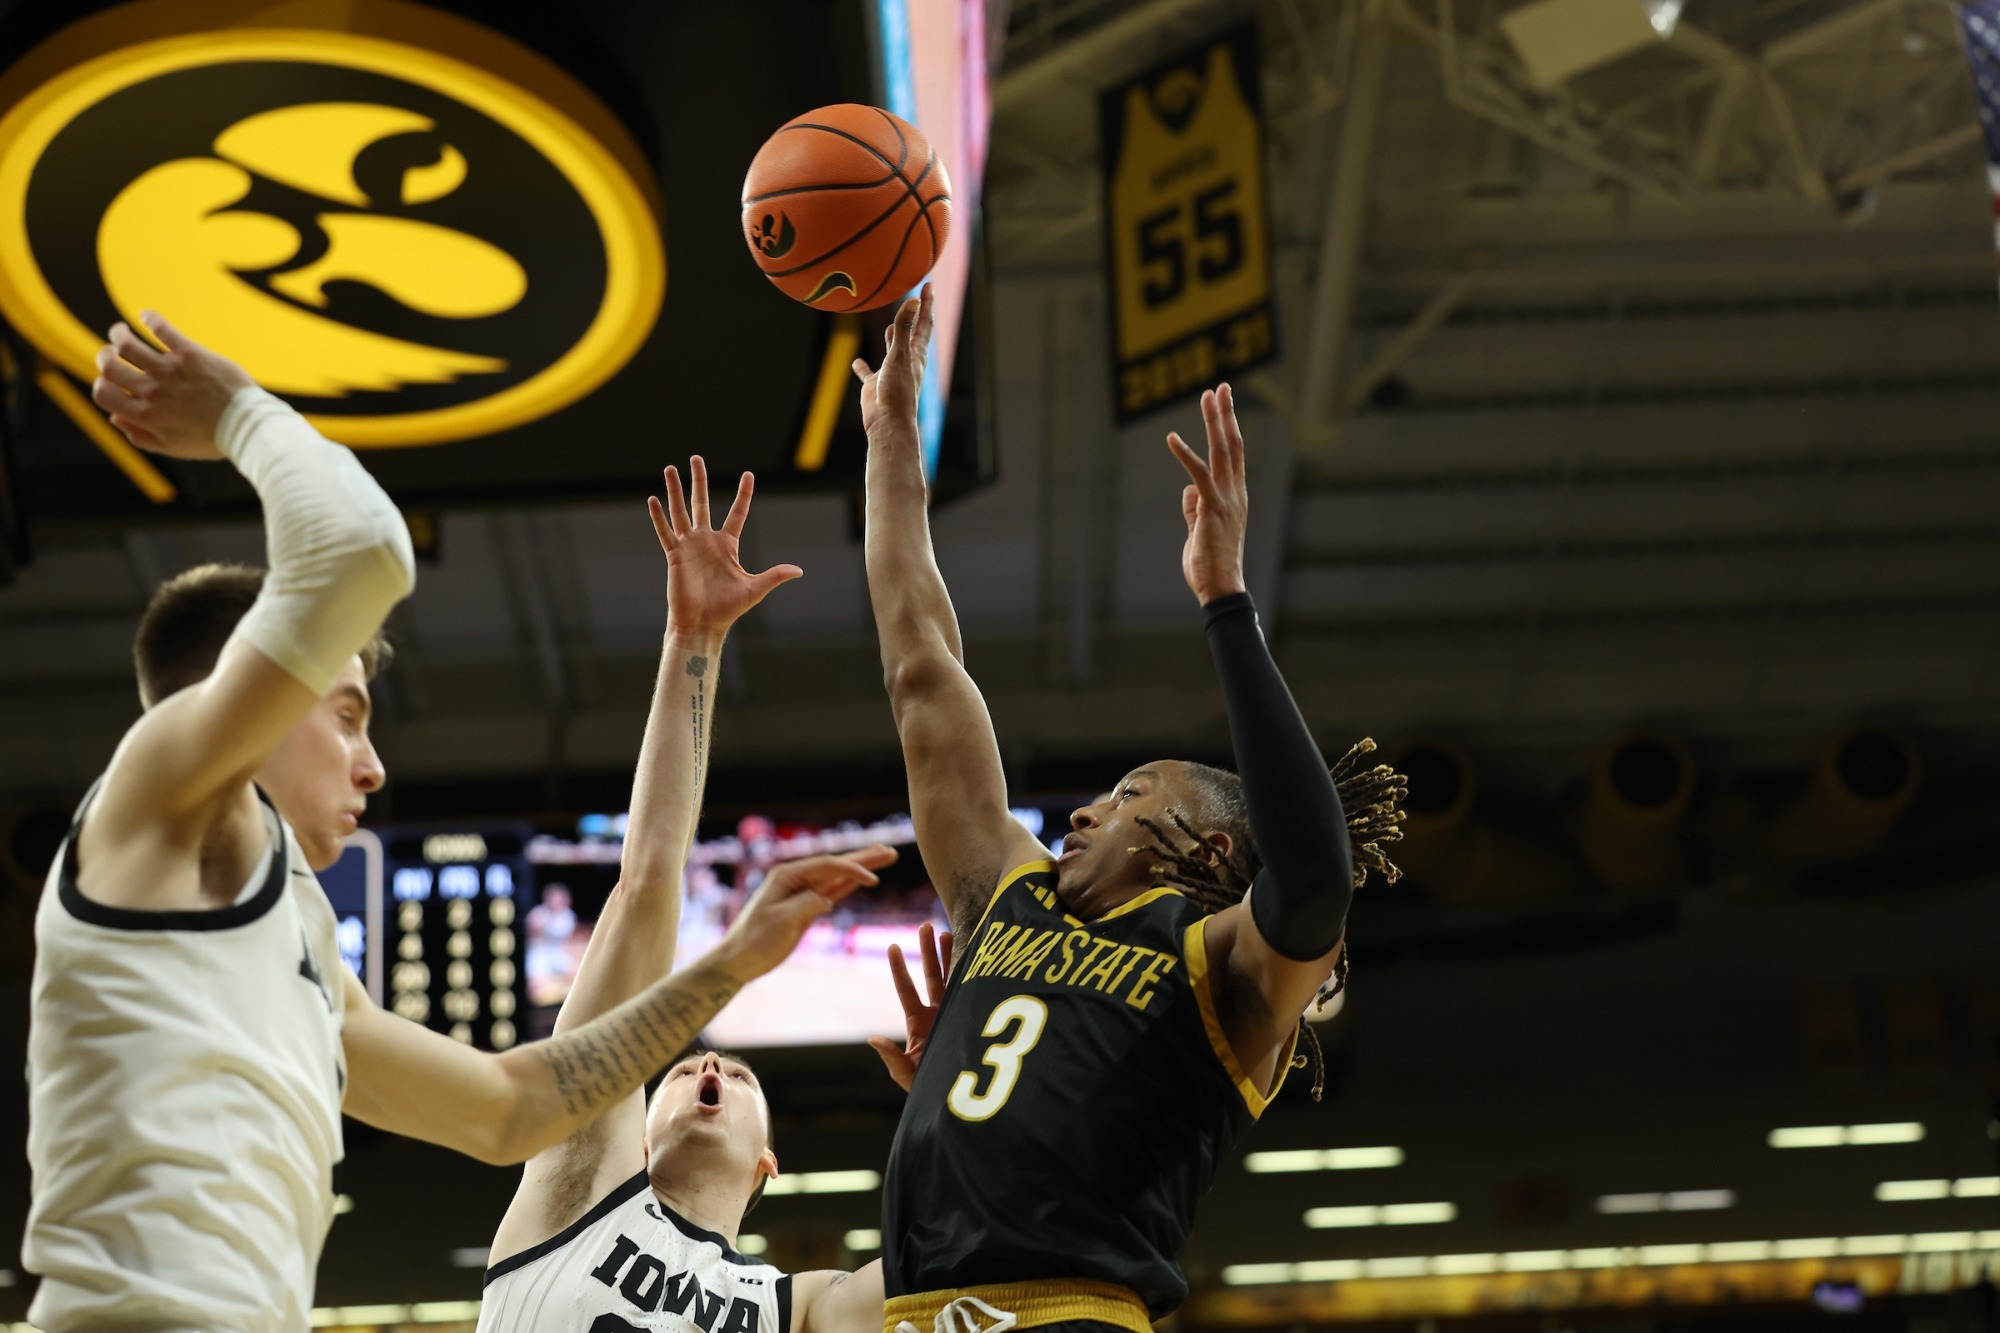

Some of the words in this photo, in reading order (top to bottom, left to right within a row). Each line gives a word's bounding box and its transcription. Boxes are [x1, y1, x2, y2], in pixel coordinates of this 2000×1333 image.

[1137, 179, 1243, 309] 55
[961, 921, 1064, 984] BAMA
[1044, 929, 1179, 1011] STATE
[947, 994, 1048, 1122] 3
[590, 1233, 760, 1333] IOWA
